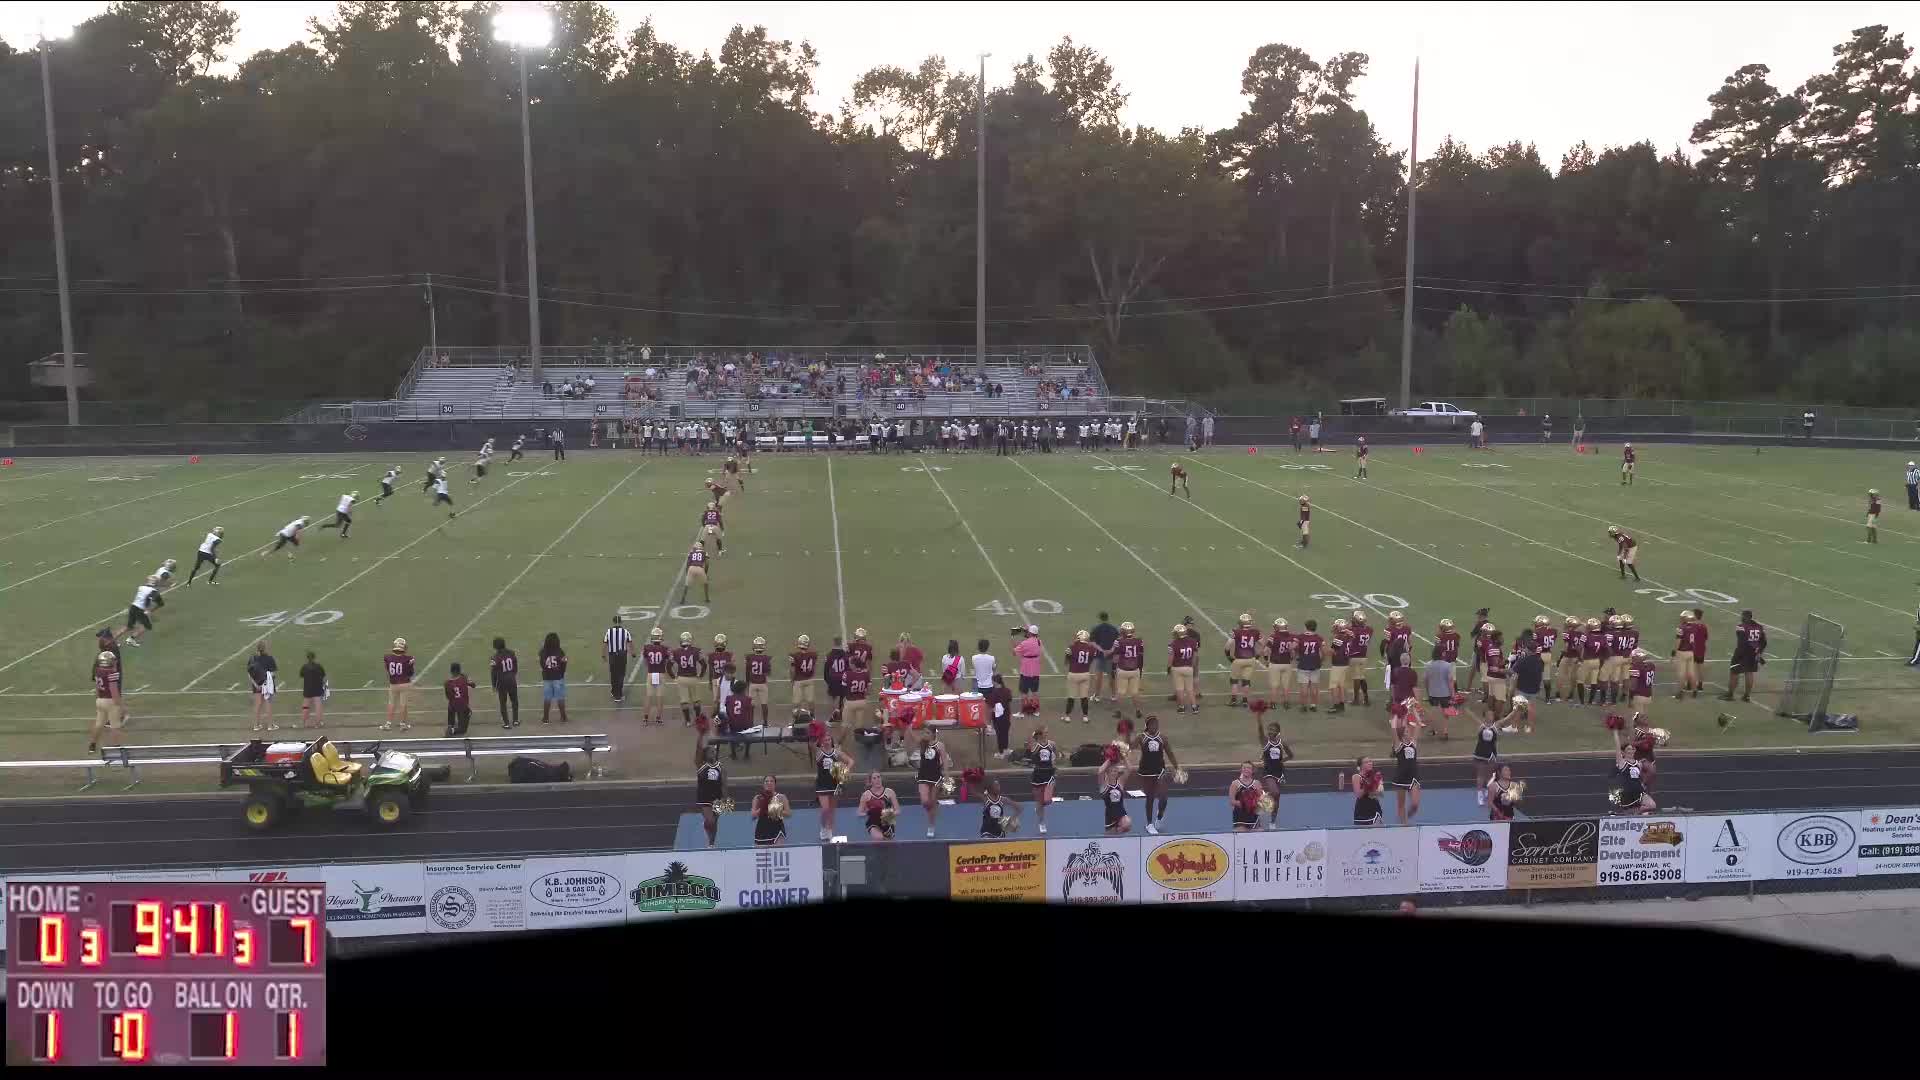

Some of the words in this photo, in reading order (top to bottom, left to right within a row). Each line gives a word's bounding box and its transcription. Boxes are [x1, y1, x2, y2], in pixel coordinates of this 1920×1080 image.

[707, 511, 717, 520] 22
[691, 552, 702, 561] 88
[1310, 593, 1409, 609] 30
[1634, 588, 1739, 603] 20
[617, 605, 711, 620] 50
[970, 599, 1064, 615] 40
[240, 610, 344, 626] 40
[1240, 636, 1254, 649] 54
[1543, 635, 1555, 649] 95
[1748, 629, 1760, 642] 55
[1125, 645, 1137, 658] 51
[1304, 642, 1316, 655] 77
[501, 657, 513, 672] 10
[545, 655, 558, 669] 45
[648, 651, 662, 665] 30
[680, 655, 694, 669] 64
[1078, 651, 1090, 664] 61
[389, 661, 403, 676] 60
[752, 661, 763, 675] 21
[801, 659, 813, 673] 44
[454, 687, 461, 698] 3
[851, 680, 865, 693] 20
[734, 700, 742, 714] 2
[970, 704, 979, 713] G
[1600, 835, 1626, 846] Site
[1800, 833, 1834, 847] KBB
[1243, 847, 1282, 865] LAND
[1599, 848, 1681, 861] Development
[1860, 847, 1880, 855] Call:
[1882, 846, 1903, 856] (919)
[956, 854, 997, 865] CertaPro
[999, 852, 1036, 862] Painters
[466, 863, 495, 871] Service
[496, 862, 522, 870] Center
[1367, 866, 1401, 875] FARMS
[545, 878, 562, 886] K.B.
[564, 876, 606, 886] JOHNSON
[1242, 865, 1323, 884] TRUFFLES
[1600, 868, 1682, 882] 919-868-3908
[380, 893, 423, 904] Pharmacy
[738, 887, 810, 908] CORNER
